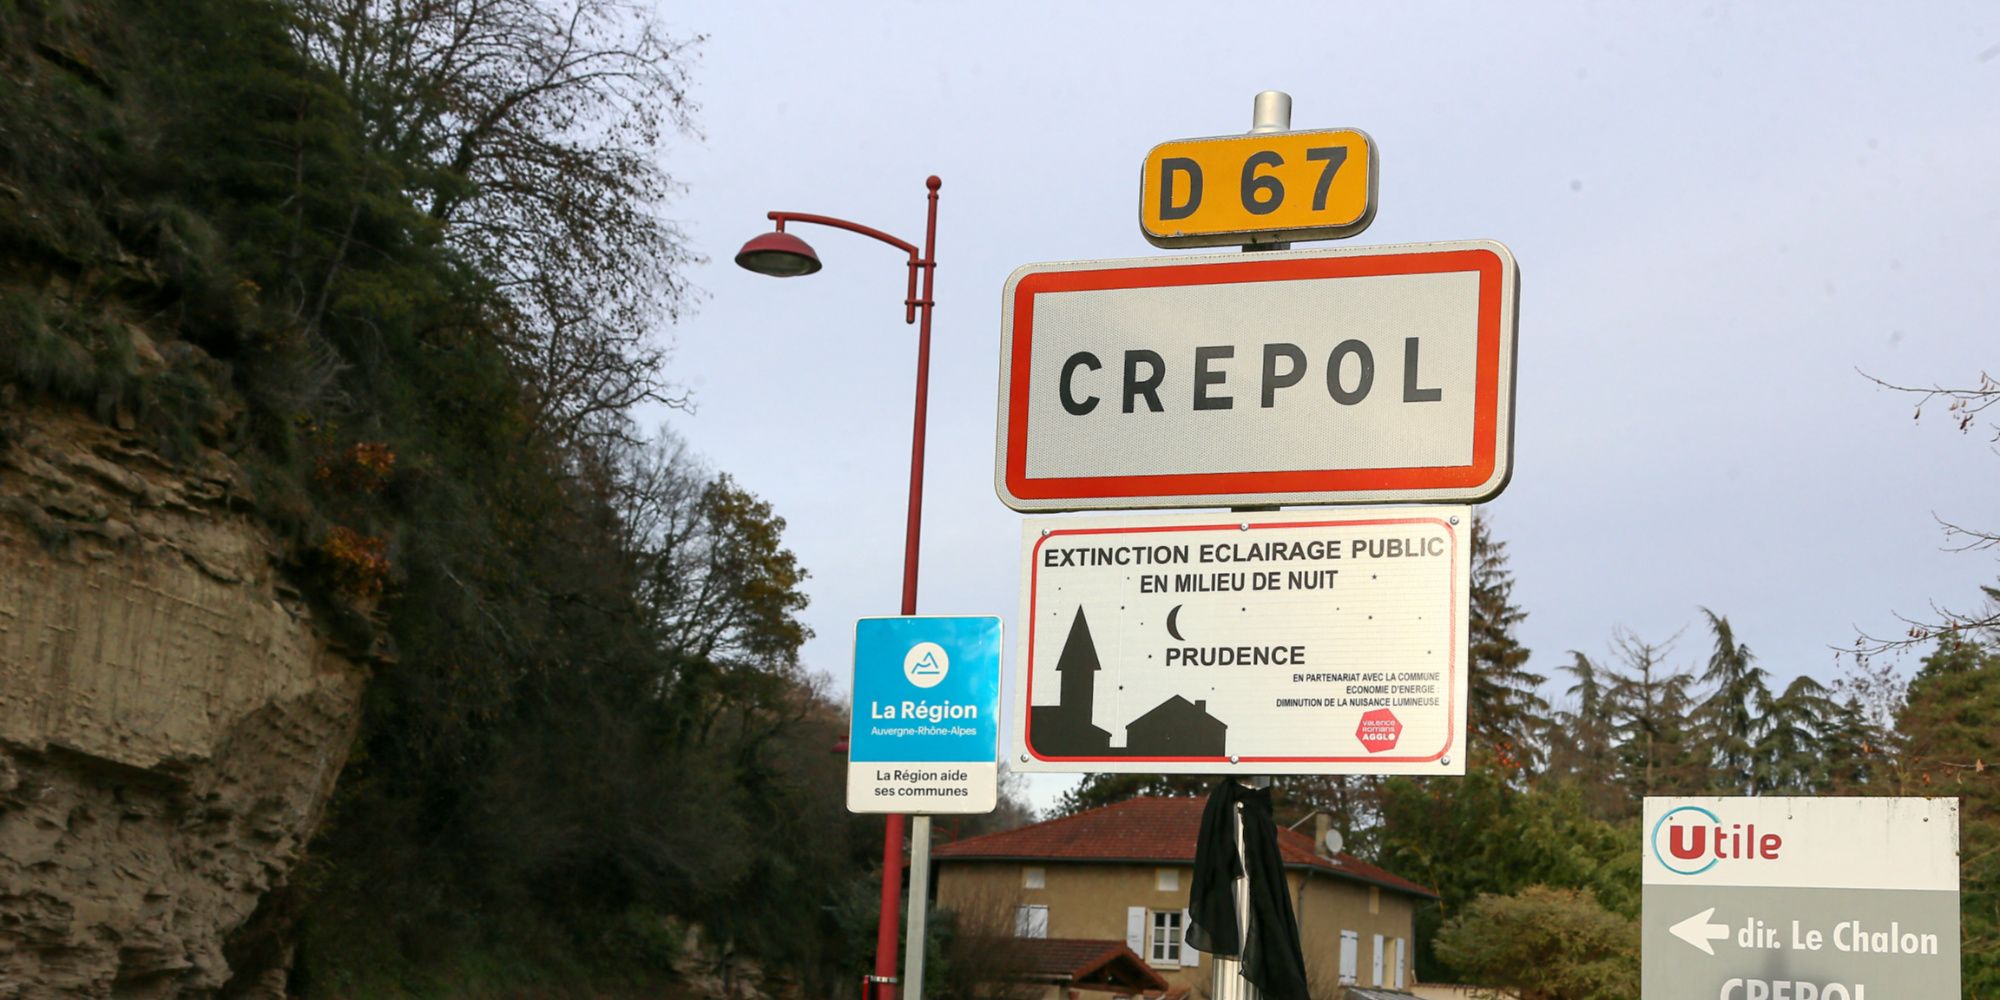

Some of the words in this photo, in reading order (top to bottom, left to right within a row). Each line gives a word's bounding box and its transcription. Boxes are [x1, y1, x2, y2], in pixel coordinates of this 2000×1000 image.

[1159, 157, 1203, 220] D
[1240, 146, 1347, 215] 67
[1059, 337, 1442, 416] CREPOL
[1044, 545, 1188, 567] EXTINCTION
[1200, 541, 1341, 563] ECLAIRAGE
[1352, 537, 1444, 558] PUBLIC
[1140, 575, 1168, 593] EN
[1175, 573, 1245, 592] MILIEU
[1253, 572, 1281, 590] DE
[1288, 570, 1338, 589] NUIT
[1165, 646, 1306, 666] PRUDENCE
[1293, 674, 1304, 682] EN
[1306, 673, 1360, 682] PARTENARIAT
[1362, 673, 1383, 682] AVEC
[1385, 673, 1396, 681] LA
[1398, 672, 1440, 681] COMMUNE
[1346, 686, 1388, 694] ECONOMIE
[1391, 685, 1435, 694] D'ENERGIE
[872, 701, 895, 719] La
[902, 700, 977, 723] Région
[1276, 699, 1322, 707] DIMINUTION
[1324, 699, 1335, 707] DE
[1337, 699, 1348, 707] LA
[1350, 699, 1390, 707] NUISANCE
[1393, 698, 1440, 706] LUMINEUSE
[871, 727, 977, 737] Auvergne-Rhône-Alpes
[877, 770, 890, 781] La
[894, 769, 937, 783] Région
[940, 770, 968, 781] aide
[875, 787, 895, 796] ses
[898, 787, 968, 796] communes
[1738, 917, 1781, 949] dir.
[1792, 920, 1823, 951] Le
[1833, 920, 1938, 955] Chalon
